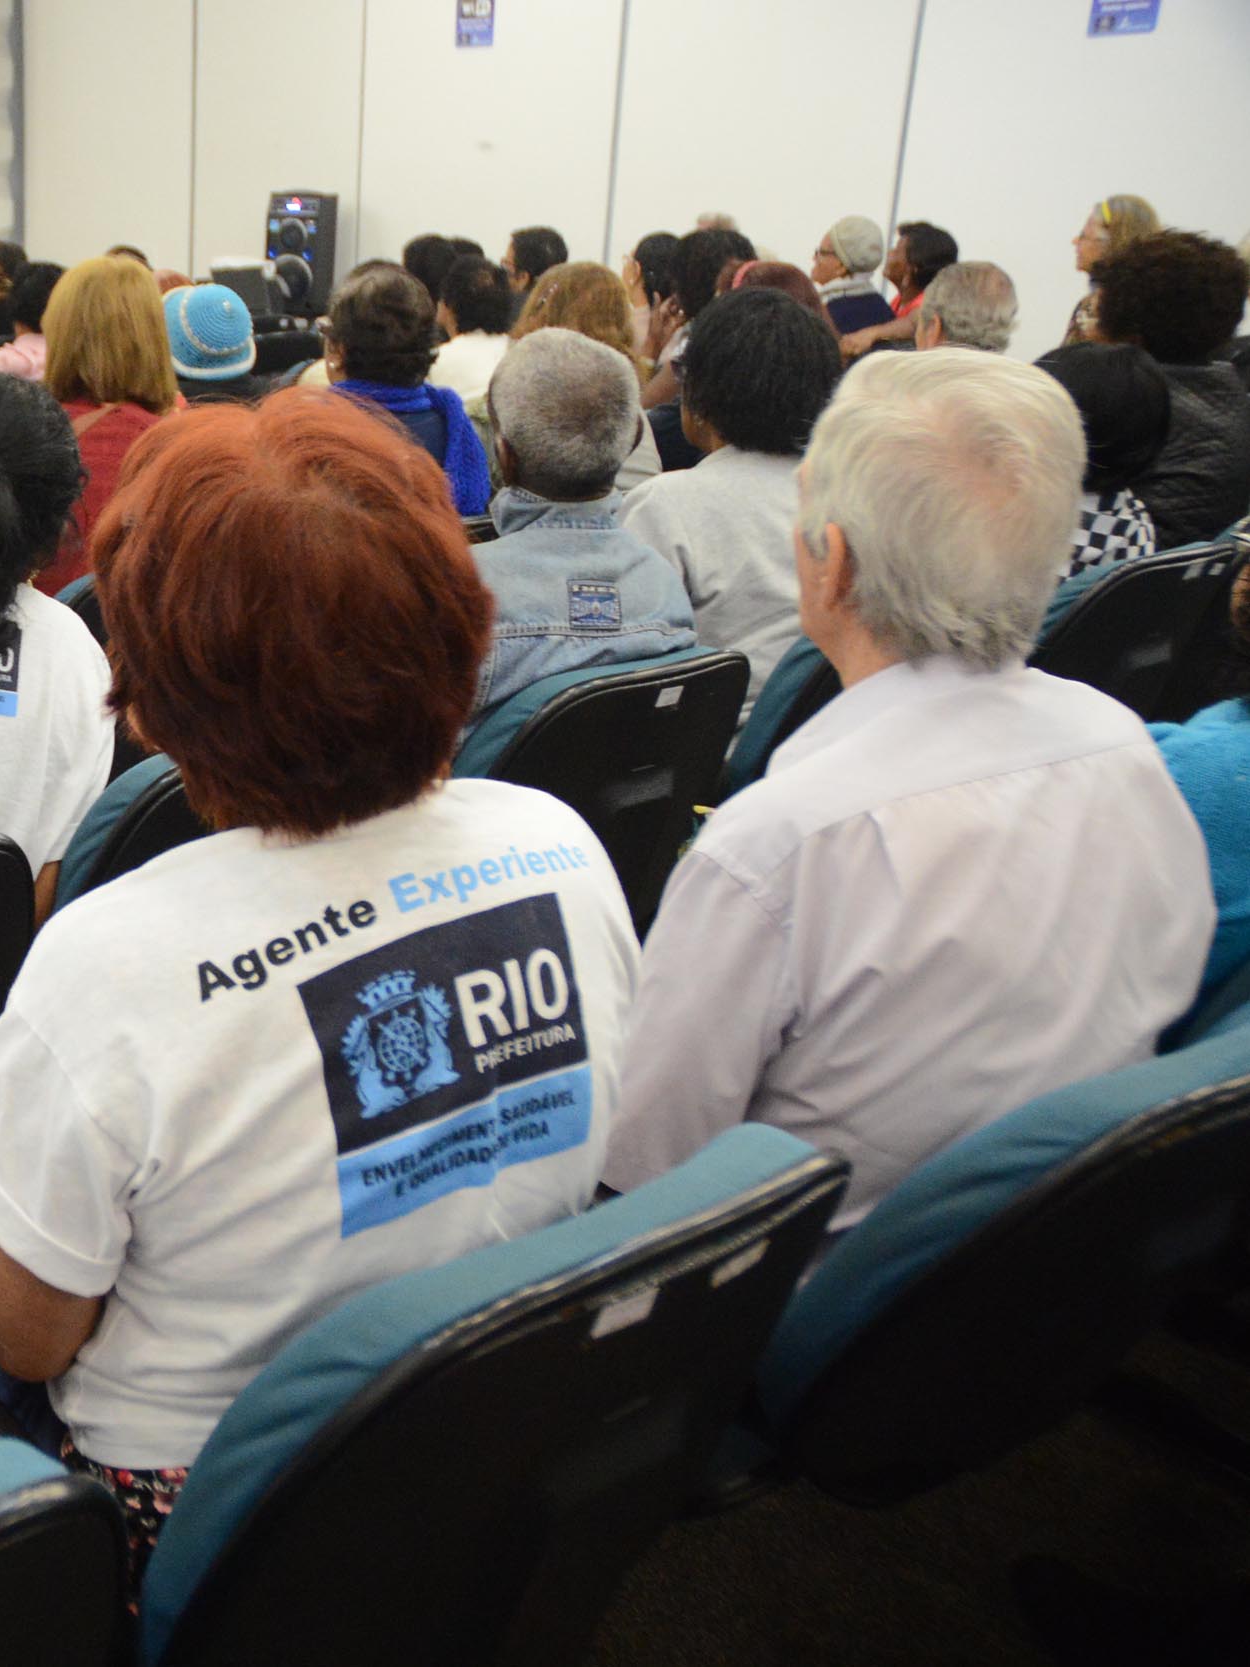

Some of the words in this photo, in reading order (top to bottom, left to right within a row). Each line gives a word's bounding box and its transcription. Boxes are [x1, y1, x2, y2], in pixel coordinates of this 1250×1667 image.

[197, 900, 378, 1002] Agente
[388, 843, 589, 913] Experiente
[454, 948, 568, 1048] RIO
[475, 1024, 576, 1074] PREFEITURA
